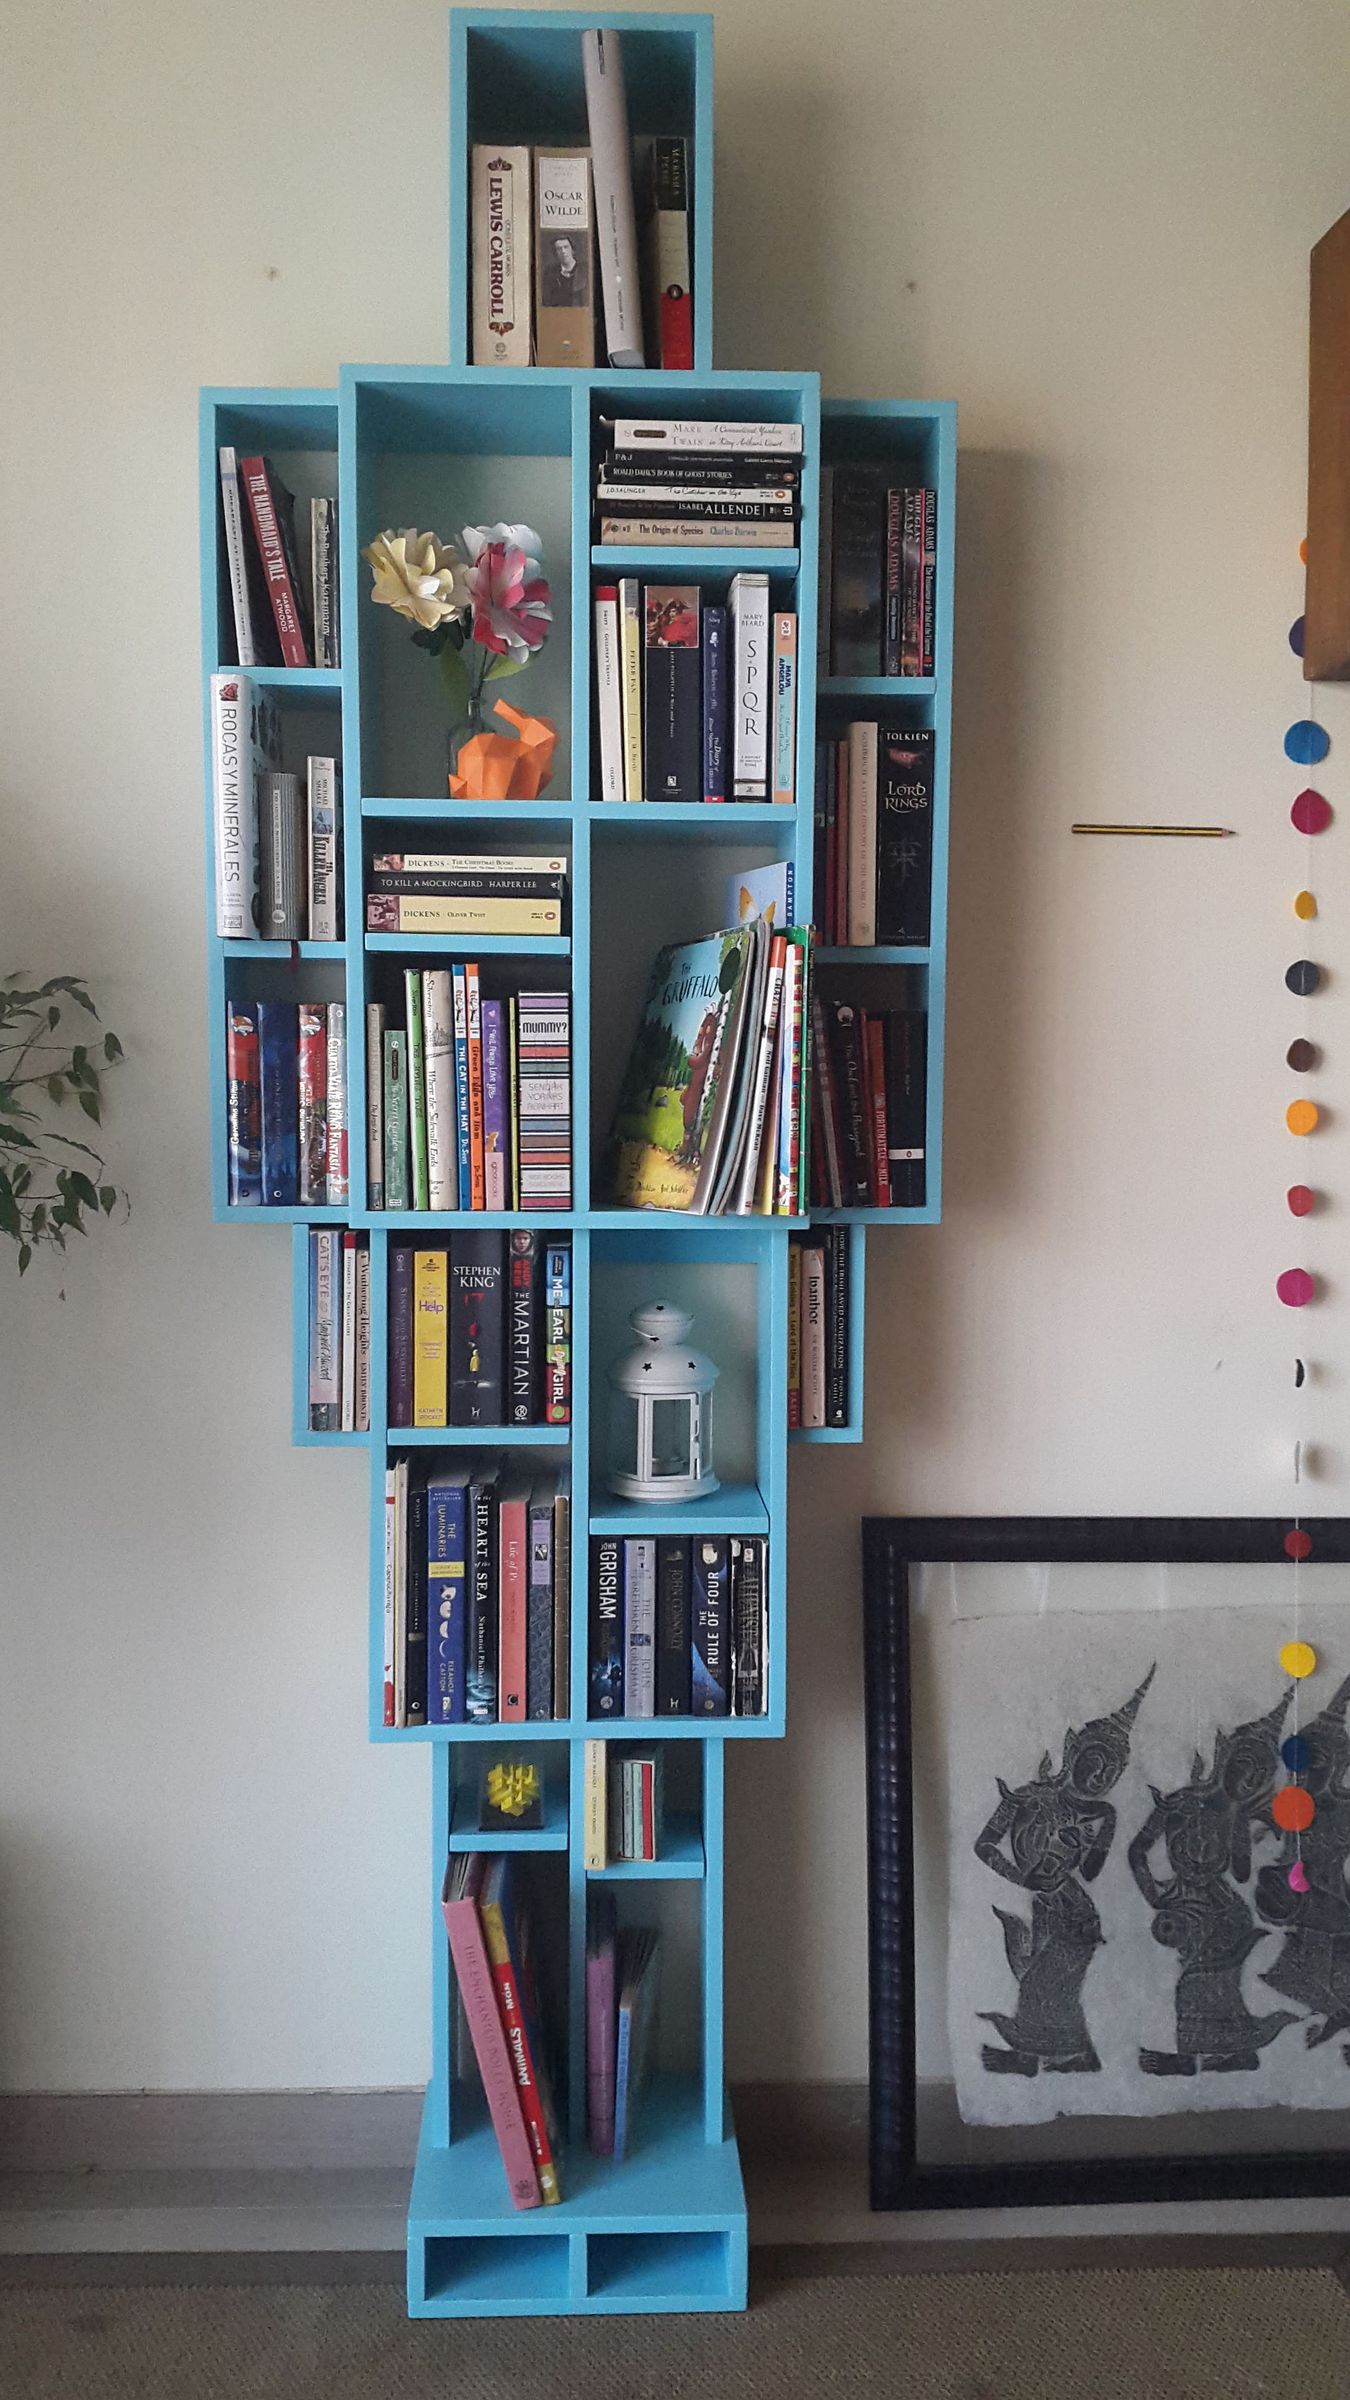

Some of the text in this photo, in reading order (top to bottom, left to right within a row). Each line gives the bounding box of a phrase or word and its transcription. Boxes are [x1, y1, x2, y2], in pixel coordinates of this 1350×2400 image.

[544, 189, 583, 201] OSCAR
[545, 205, 584, 216] WILDE
[489, 177, 503, 318] LEWIS CARROLL
[671, 436, 703, 445] TWAIN
[672, 424, 702, 433] MARK
[678, 502, 704, 510] ISABEL
[705, 504, 760, 515] ALLENDE
[248, 474, 287, 581] THE HANDMAID'S TALE
[639, 524, 704, 535] The Origin of Species
[275, 598, 288, 632] ATWOOD
[281, 592, 296, 634] MARGARET
[778, 657, 786, 696] ANGELOU
[220, 708, 238, 767] ROCAS
[886, 732, 929, 741] TOLKIEN
[223, 769, 237, 779] Y
[887, 780, 926, 797] LORD
[885, 796, 928, 814] RINGS
[222, 782, 240, 882] MINERALES
[313, 836, 329, 905] KILLER ANGELS
[408, 859, 446, 867] DICKENS
[381, 879, 483, 888] TO KILL A MOCKINGBIRD
[403, 910, 440, 918] DICKENS
[681, 962, 693, 975] THE
[425, 978, 436, 1017] Silverstein
[662, 974, 719, 1006] GRUFFALO
[522, 1021, 567, 1034] MUMMY?
[458, 1046, 466, 1062] THE
[472, 1046, 480, 1072] Green
[459, 1065, 467, 1081] CAT
[460, 1084, 467, 1093] IN
[392, 1095, 400, 1119] Secret
[428, 1069, 438, 1167] Where the Sidewalk Ends
[473, 1101, 481, 1117] and
[386, 1119, 402, 1152] Garden
[460, 1114, 469, 1132] HAT
[473, 1120, 481, 1139] Ham
[876, 1110, 888, 1185] FORTUNATELY MILK
[319, 1235, 330, 1298] CAT'S EYE
[452, 1266, 500, 1276] STEPHEN
[459, 1276, 495, 1288] KING
[359, 1263, 369, 1356] Wuthering Heights
[418, 1299, 444, 1314] Help
[809, 1276, 820, 1325] Ivanhoe
[513, 1299, 530, 1395] MARTIAN
[553, 1278, 564, 1404] ME EARL GIRL
[437, 1504, 446, 1558] LUMINARIES
[447, 1522, 455, 1539] THE
[476, 1504, 488, 1558] HEART
[508, 1540, 519, 1557] Life
[600, 1542, 617, 1550] JOHN
[476, 1572, 488, 1601] SEA
[599, 1551, 617, 1619] GRISHAM
[631, 1578, 641, 1632] BRETHREN
[699, 1610, 707, 1626] THE
[707, 1571, 719, 1665] RULE OF FOUR
[478, 1615, 486, 1653] Nathaniel
[447, 1660, 455, 1693] ELEANOR
[630, 1647, 639, 1698] GRISHAM
[641, 1658, 651, 1689] JOHN
[509, 2026, 532, 2087] ANIMALS
